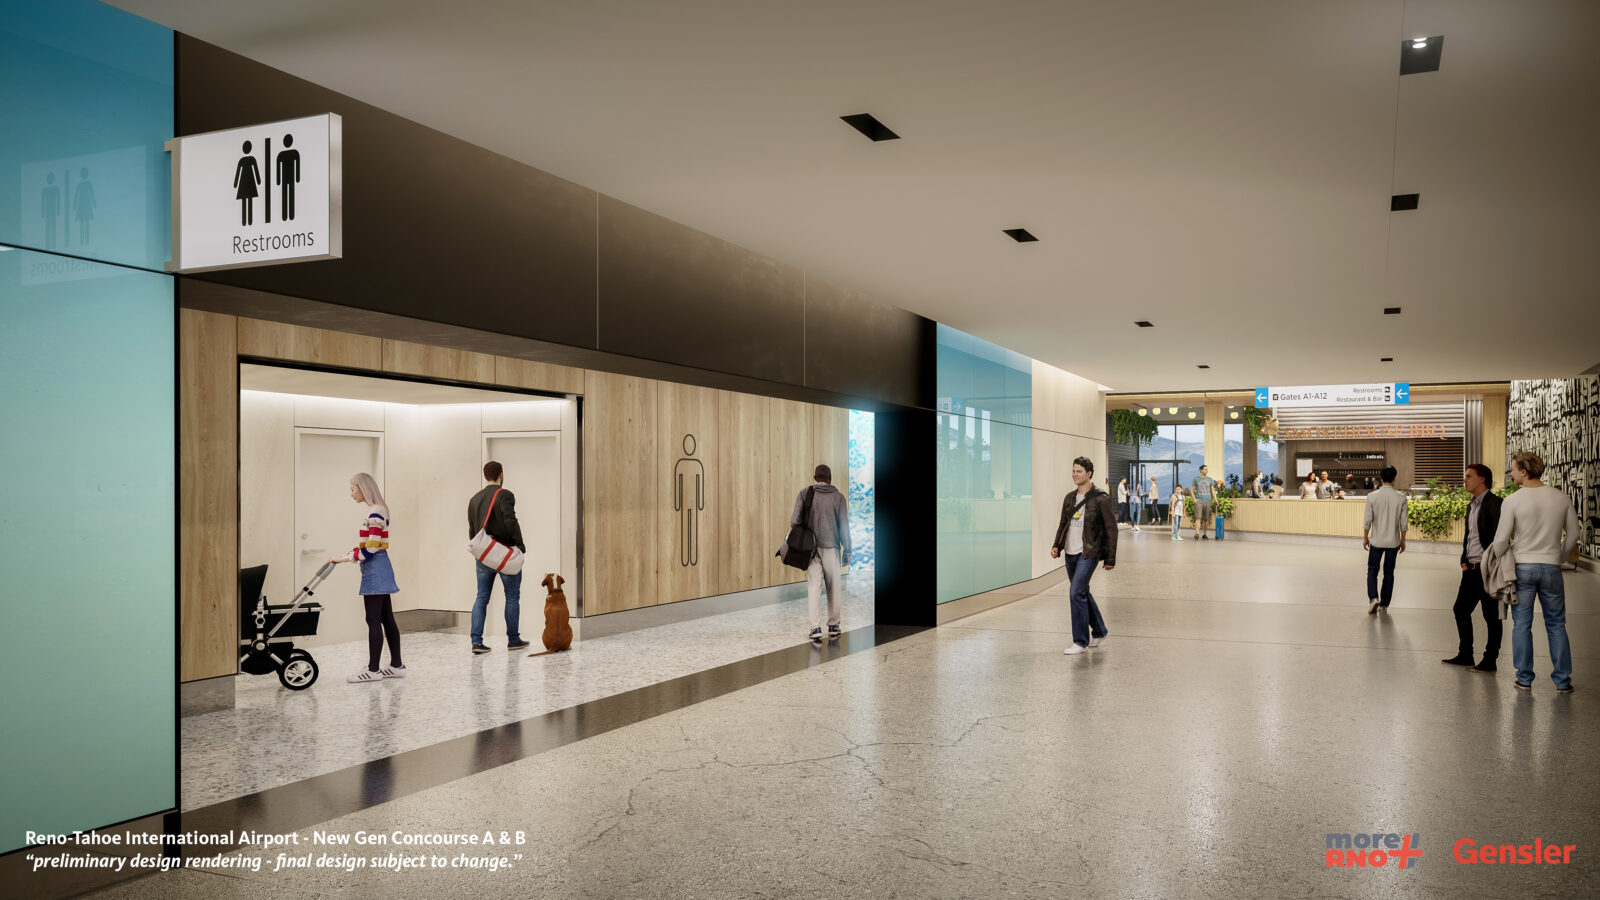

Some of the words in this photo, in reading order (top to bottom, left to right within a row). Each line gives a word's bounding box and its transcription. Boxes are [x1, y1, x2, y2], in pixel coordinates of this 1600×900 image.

[232, 231, 314, 254] Restrooms
[1280, 393, 1301, 401] Gates
[1303, 392, 1328, 400] A1-A12
[1283, 424, 1404, 440] SMOKEHOUSE
[1409, 423, 1447, 440] BBQ
